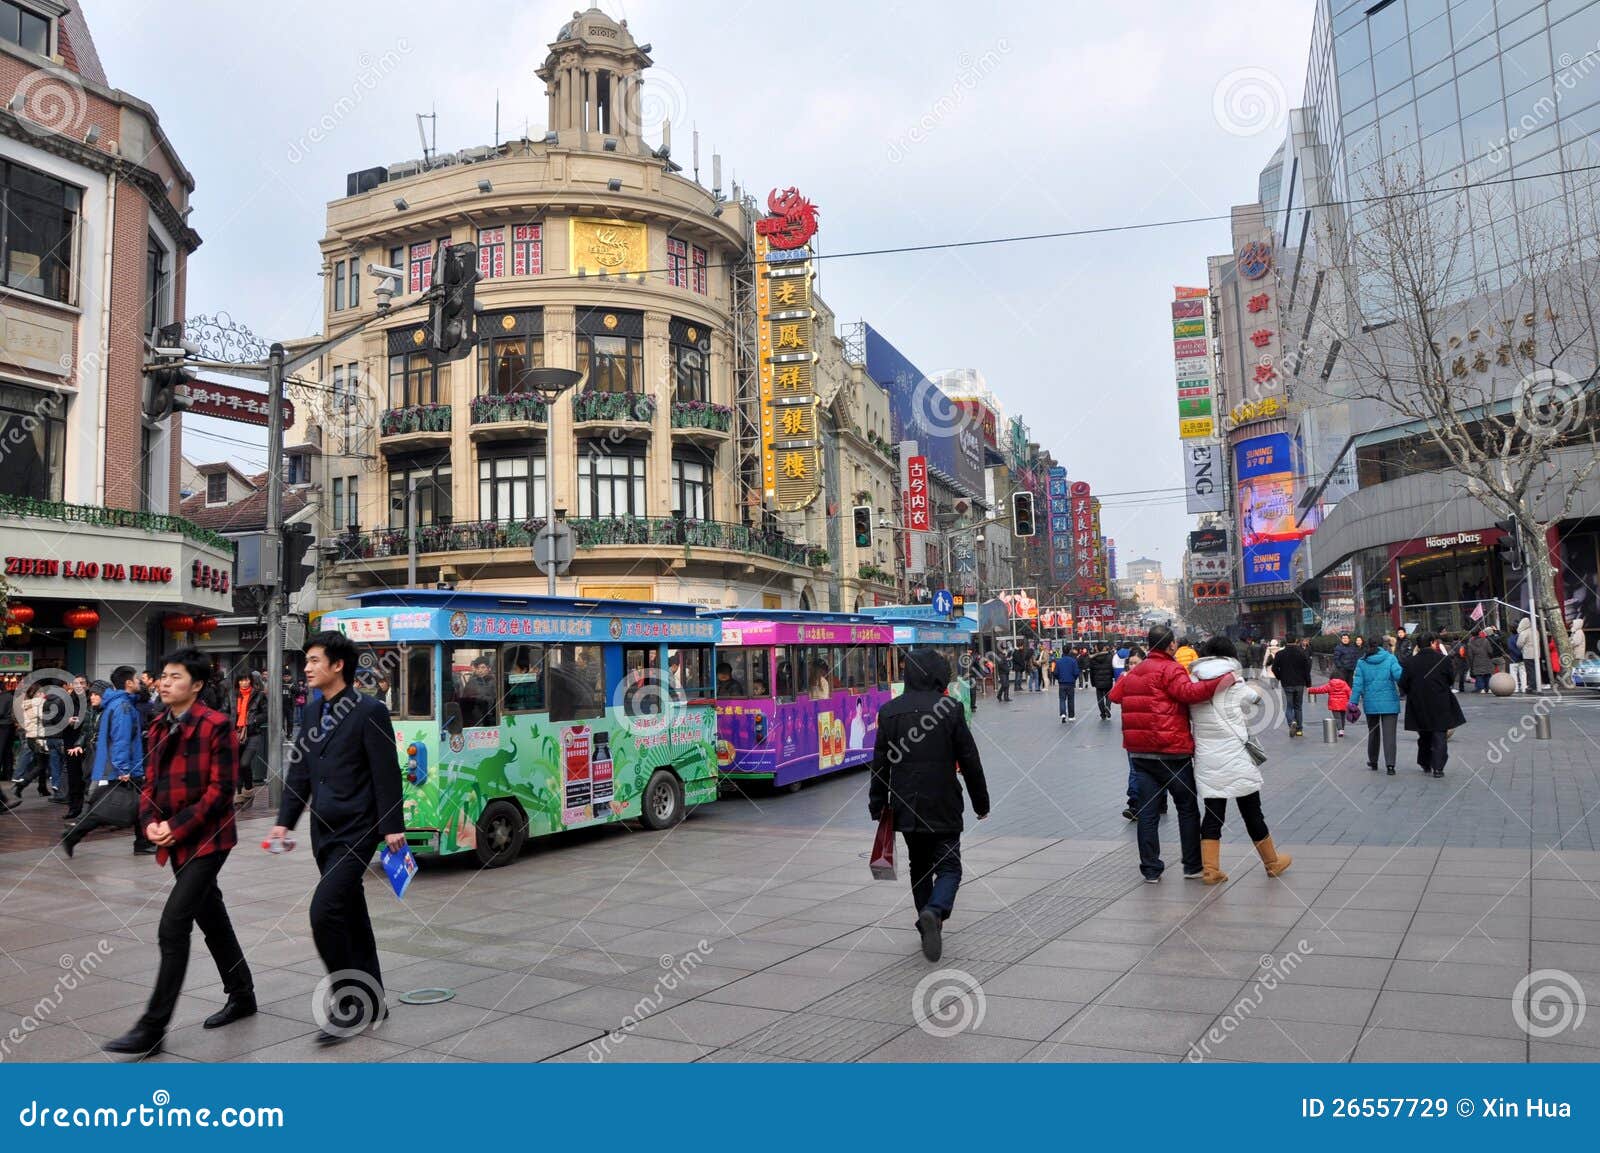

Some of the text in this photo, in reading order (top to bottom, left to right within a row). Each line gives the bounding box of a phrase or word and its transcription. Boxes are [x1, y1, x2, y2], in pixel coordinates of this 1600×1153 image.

[909, 463, 926, 524] 古今内衣
[5, 556, 172, 583] ZHEN LAO DA FANG
